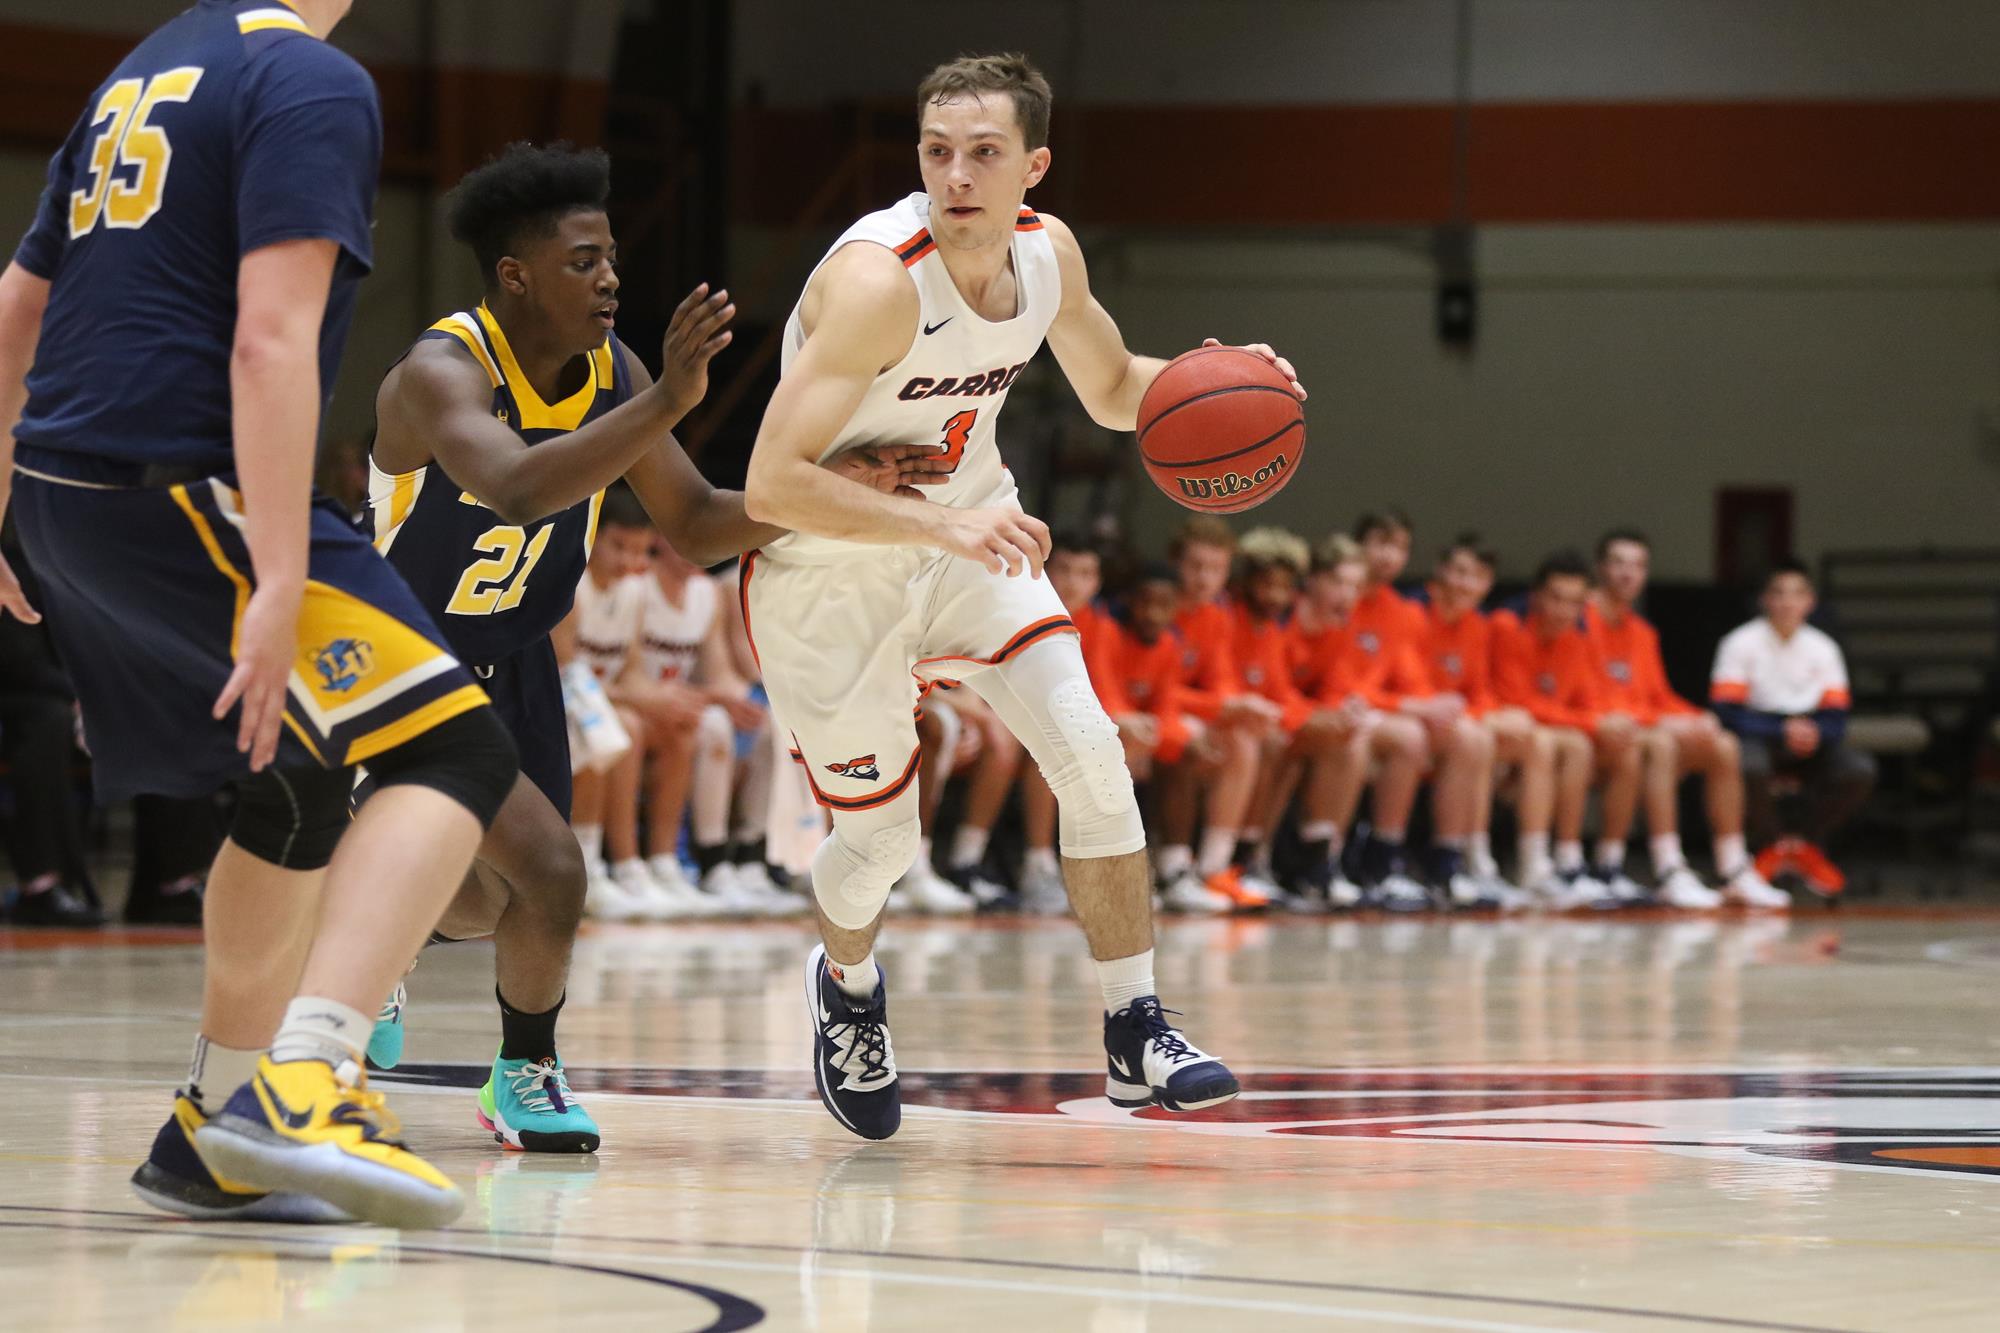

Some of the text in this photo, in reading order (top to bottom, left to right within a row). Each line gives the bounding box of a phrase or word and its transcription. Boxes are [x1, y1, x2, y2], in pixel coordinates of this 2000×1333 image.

[69, 66, 205, 240] 35
[927, 408, 978, 473] 3
[1176, 453, 1288, 499] Wilson
[444, 522, 555, 616] 21
